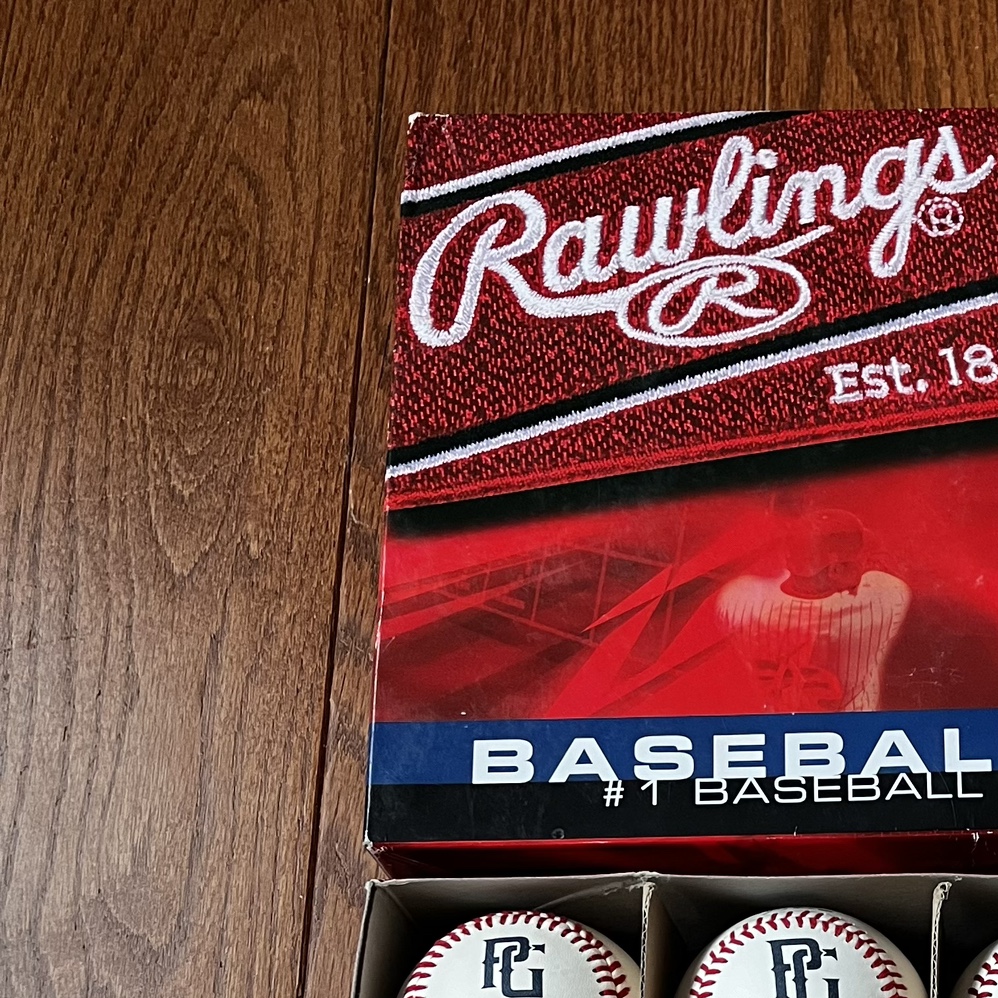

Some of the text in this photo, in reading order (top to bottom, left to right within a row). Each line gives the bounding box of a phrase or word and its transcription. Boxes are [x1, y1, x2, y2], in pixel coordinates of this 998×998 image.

[408, 125, 996, 349] Rawlings
[827, 360, 928, 404] Est.
[694, 771, 984, 805] BASEBALL
